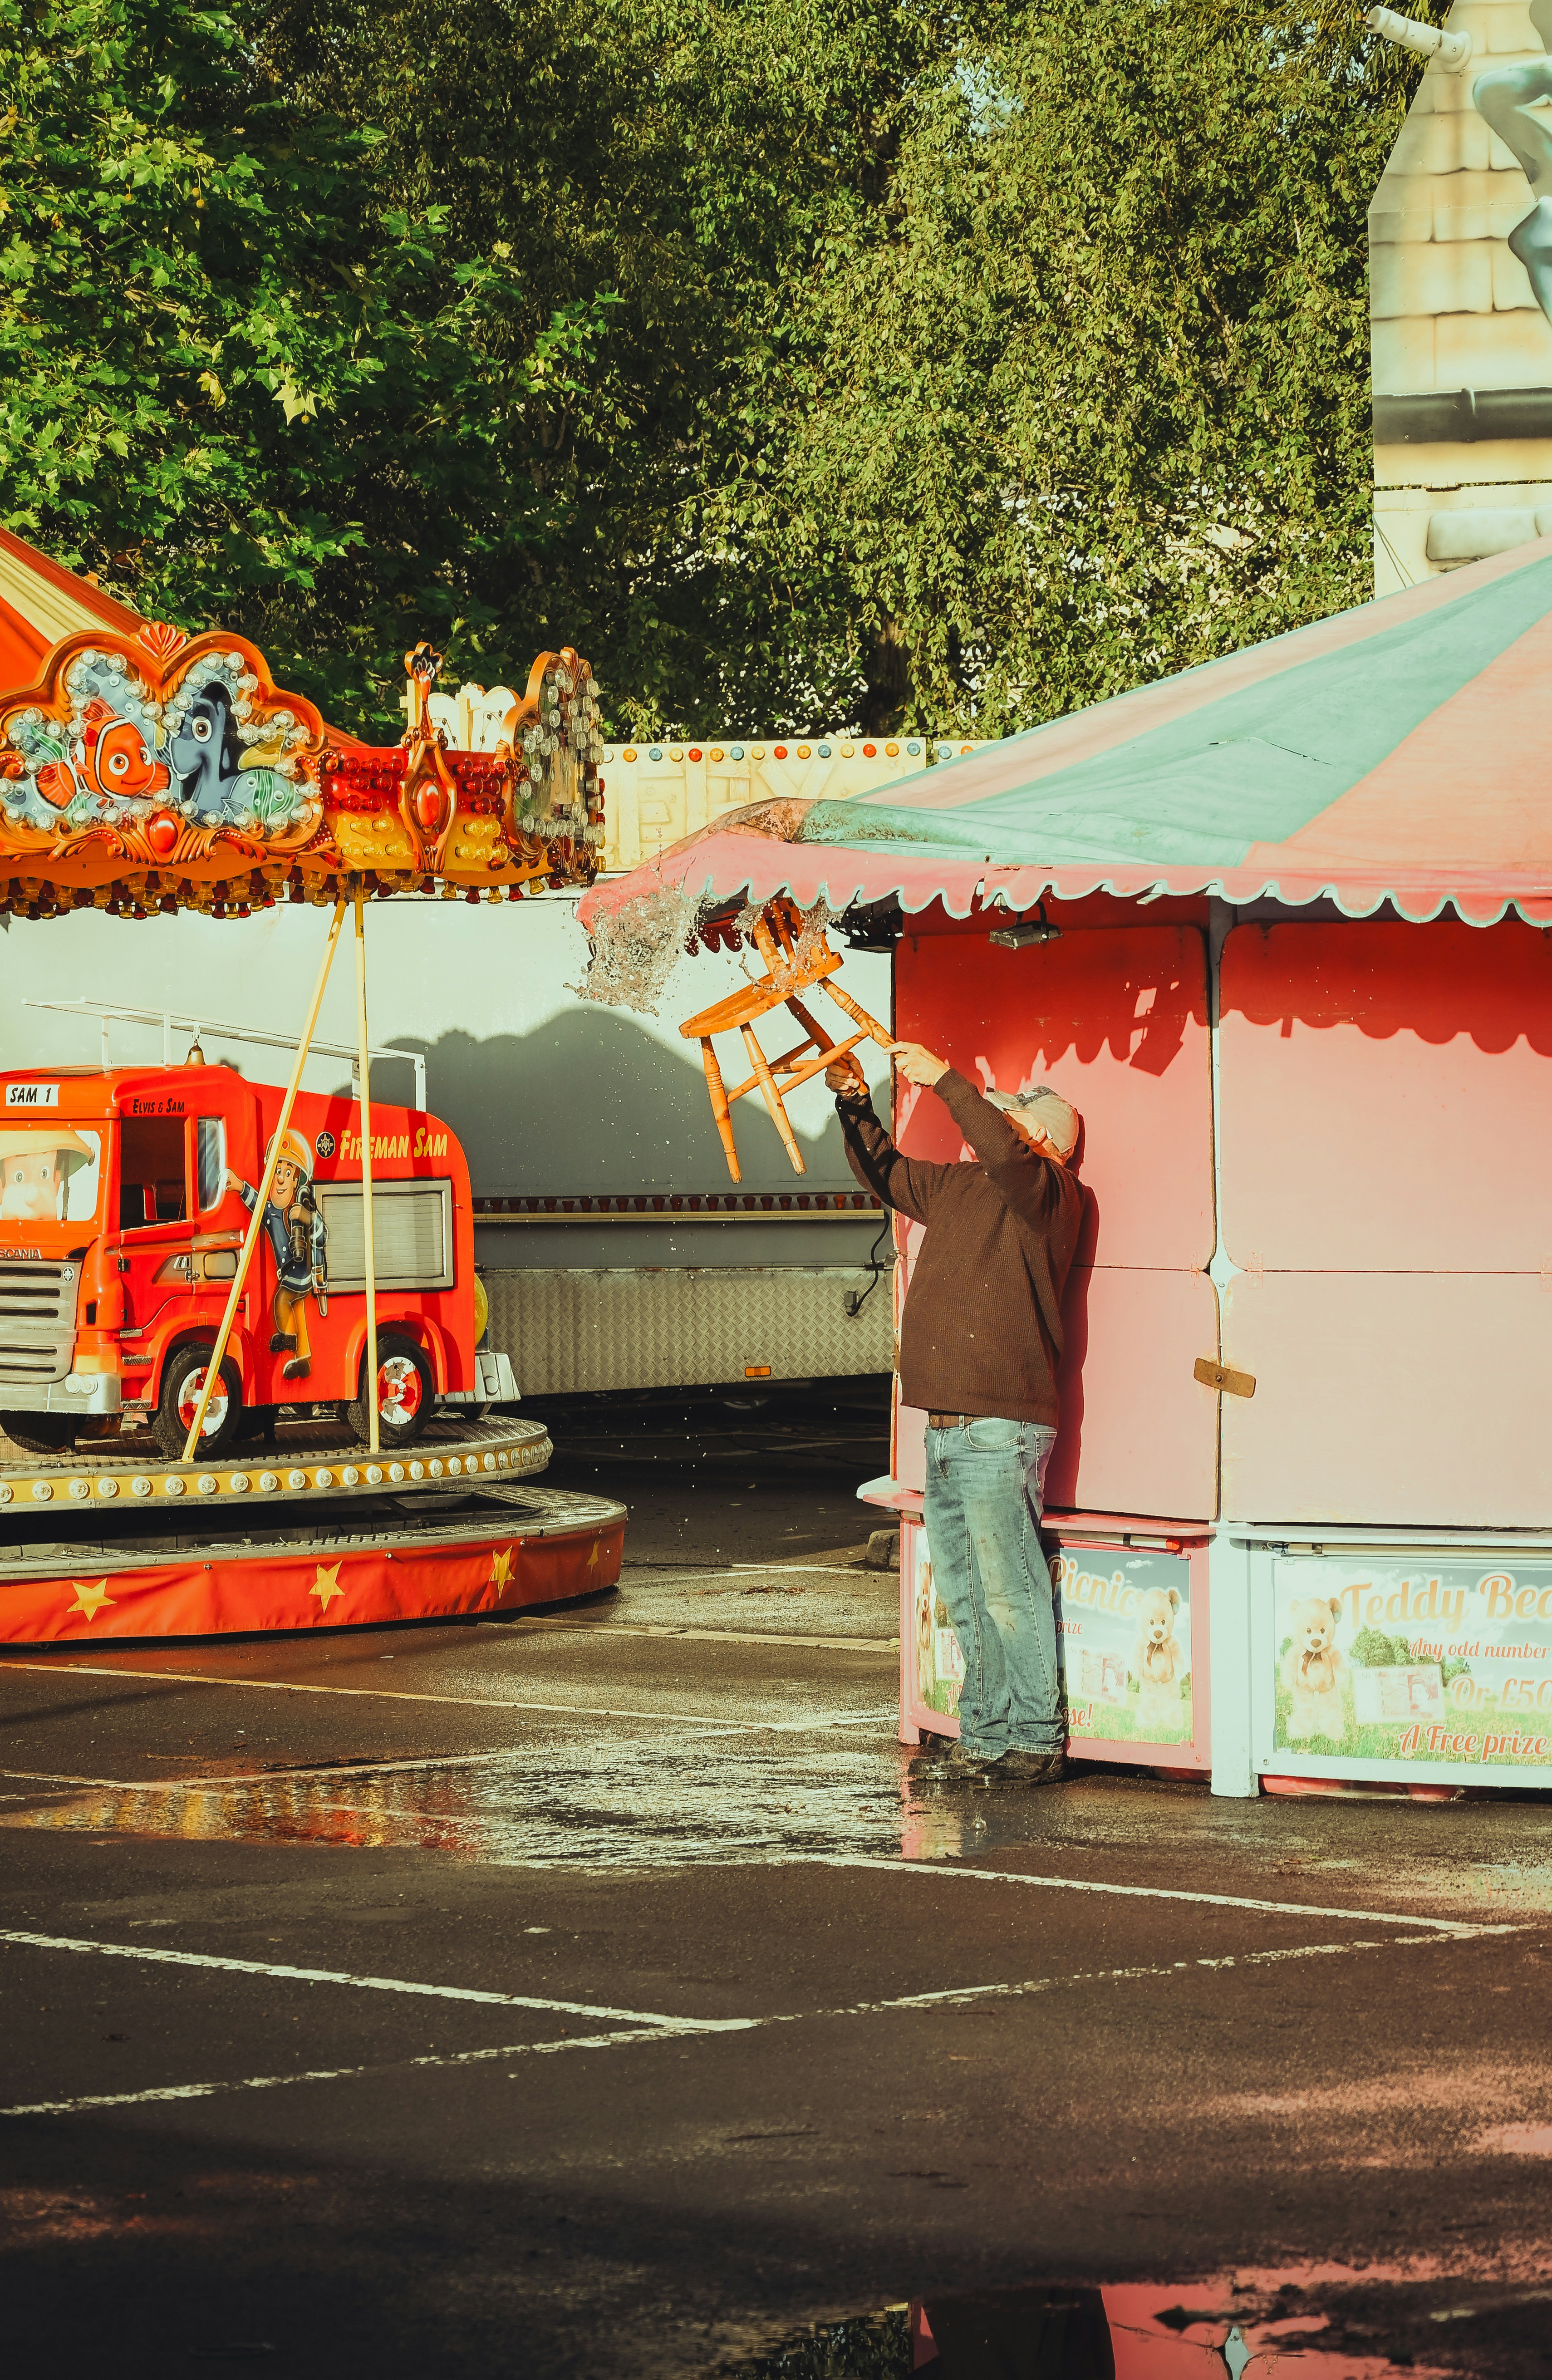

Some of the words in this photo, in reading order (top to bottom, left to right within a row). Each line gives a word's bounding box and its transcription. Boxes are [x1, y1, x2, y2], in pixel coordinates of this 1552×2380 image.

[10, 1087, 38, 1103] SAM
[45, 1087, 52, 1102] 1
[133, 1098, 156, 1114] ELVIS
[157, 1101, 163, 1112] &
[166, 1097, 185, 1113] SAM
[413, 1127, 447, 1158] SAM
[0, 1249, 42, 1259] SCANIA
[1047, 1555, 1140, 1618] Picnic
[1340, 1579, 1470, 1634] Teddy
[1410, 1638, 1443, 1662] Any
[1448, 1641, 1480, 1657] odd
[1484, 1642, 1551, 1659] number
[1451, 1677, 1490, 1708] Or
[1400, 1725, 1420, 1753] A
[1426, 1726, 1479, 1753] Free
[1482, 1730, 1548, 1761] prize
